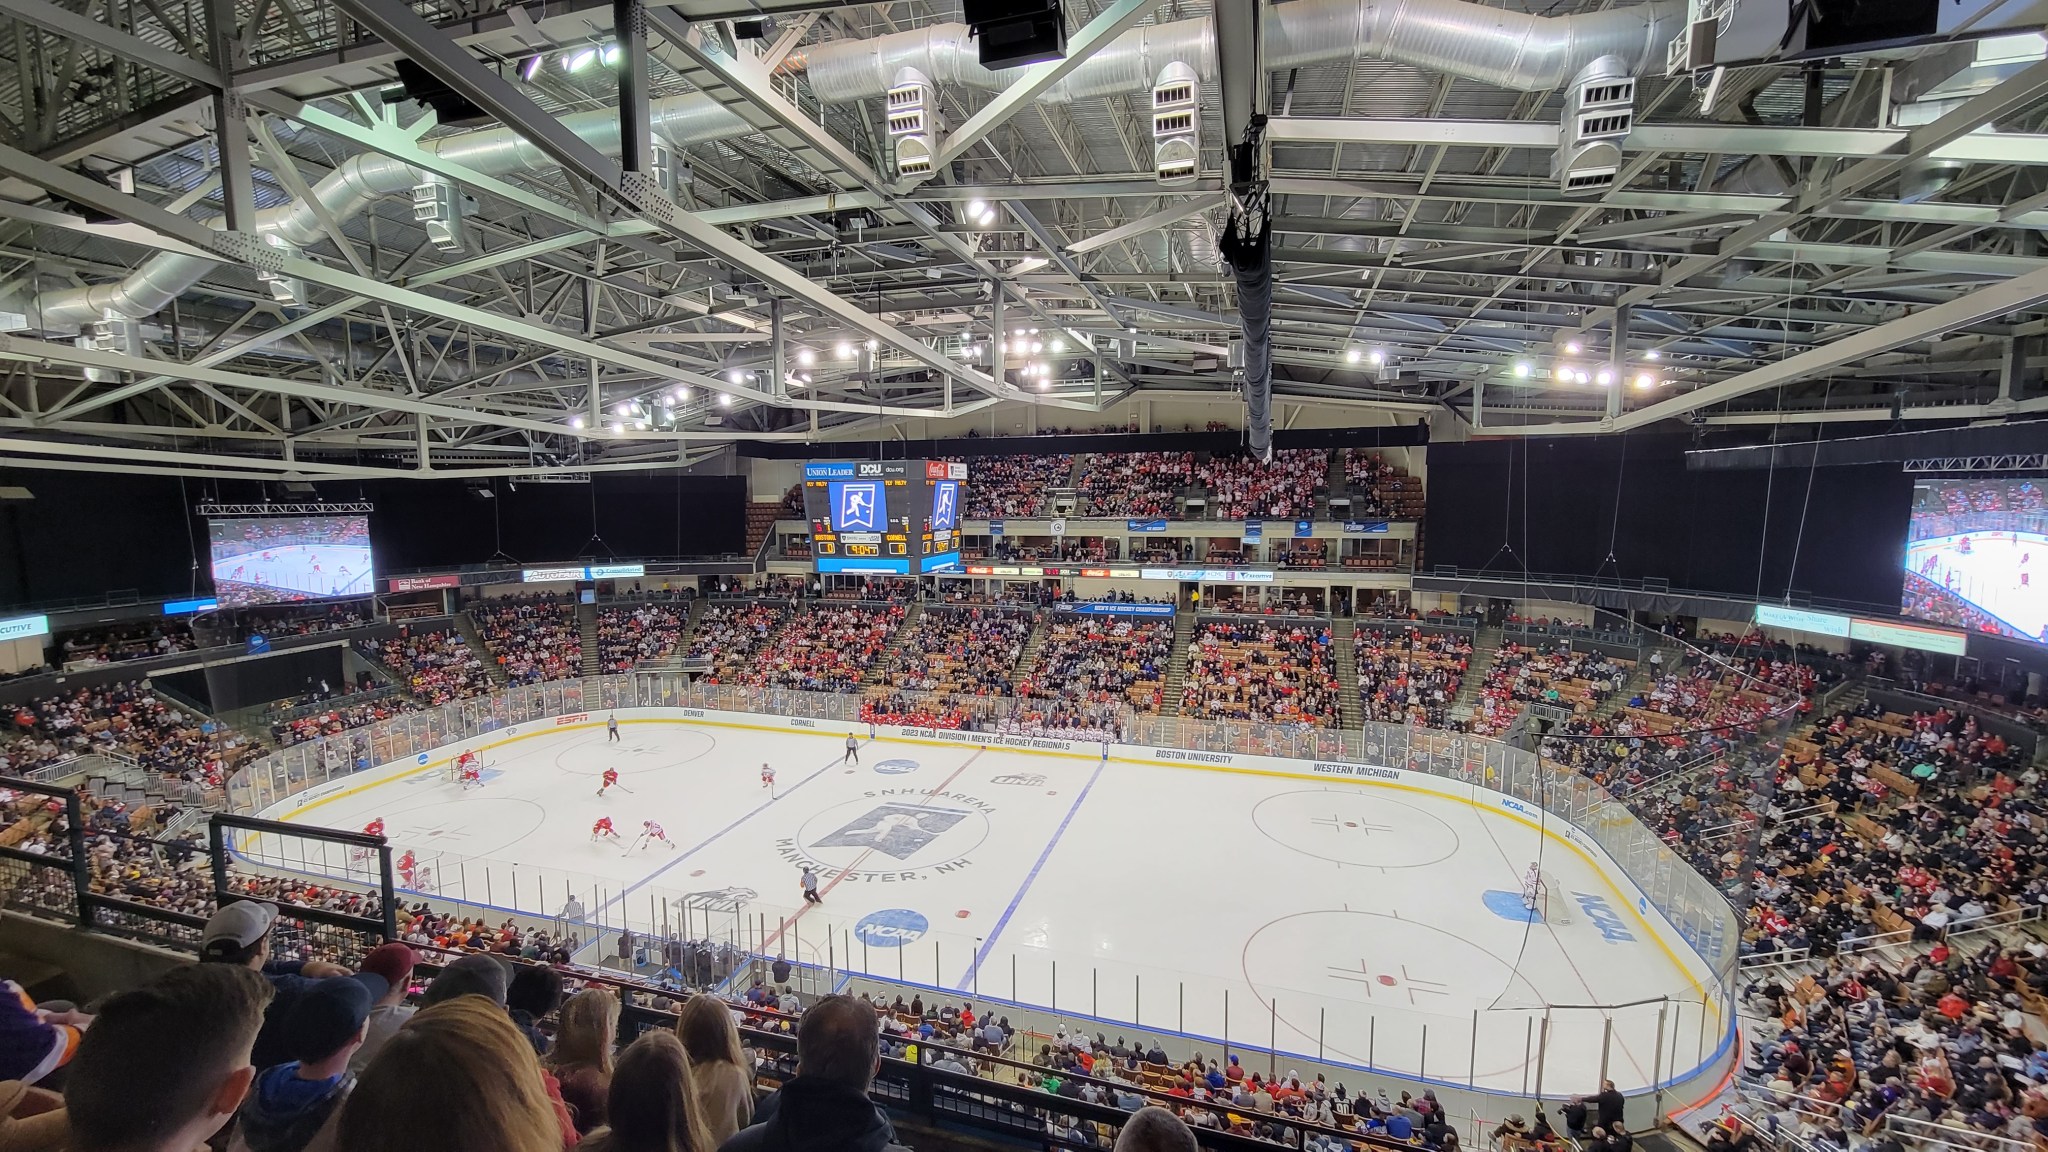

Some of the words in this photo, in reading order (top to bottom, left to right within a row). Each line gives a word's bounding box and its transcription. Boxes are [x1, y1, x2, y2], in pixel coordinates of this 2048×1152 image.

[807, 467, 827, 476] UNION
[828, 467, 854, 476] LEADER
[861, 464, 882, 474] DCU
[556, 713, 589, 726] ESPN
[683, 710, 705, 718] DENVER
[790, 718, 816, 728] CORNELL
[901, 728, 919, 738] 2023
[919, 730, 936, 739] NCAA
[938, 731, 966, 741] DIVISION
[971, 733, 992, 744] MEN'S
[993, 736, 1004, 745] ICE
[1005, 736, 1032, 748] HOCKEY
[1155, 749, 1186, 760] BOSTON
[1187, 751, 1233, 764] UNIVERSITY
[1313, 763, 1353, 775] WESTERN
[1356, 766, 1400, 780] MICHIGAN
[863, 788, 934, 799] SNHU
[941, 790, 996, 816] ARENA
[1501, 798, 1538, 819] NCAA.com
[935, 858, 973, 875] NH
[1570, 891, 1638, 943] NCAA
[858, 923, 922, 942] NCAA
